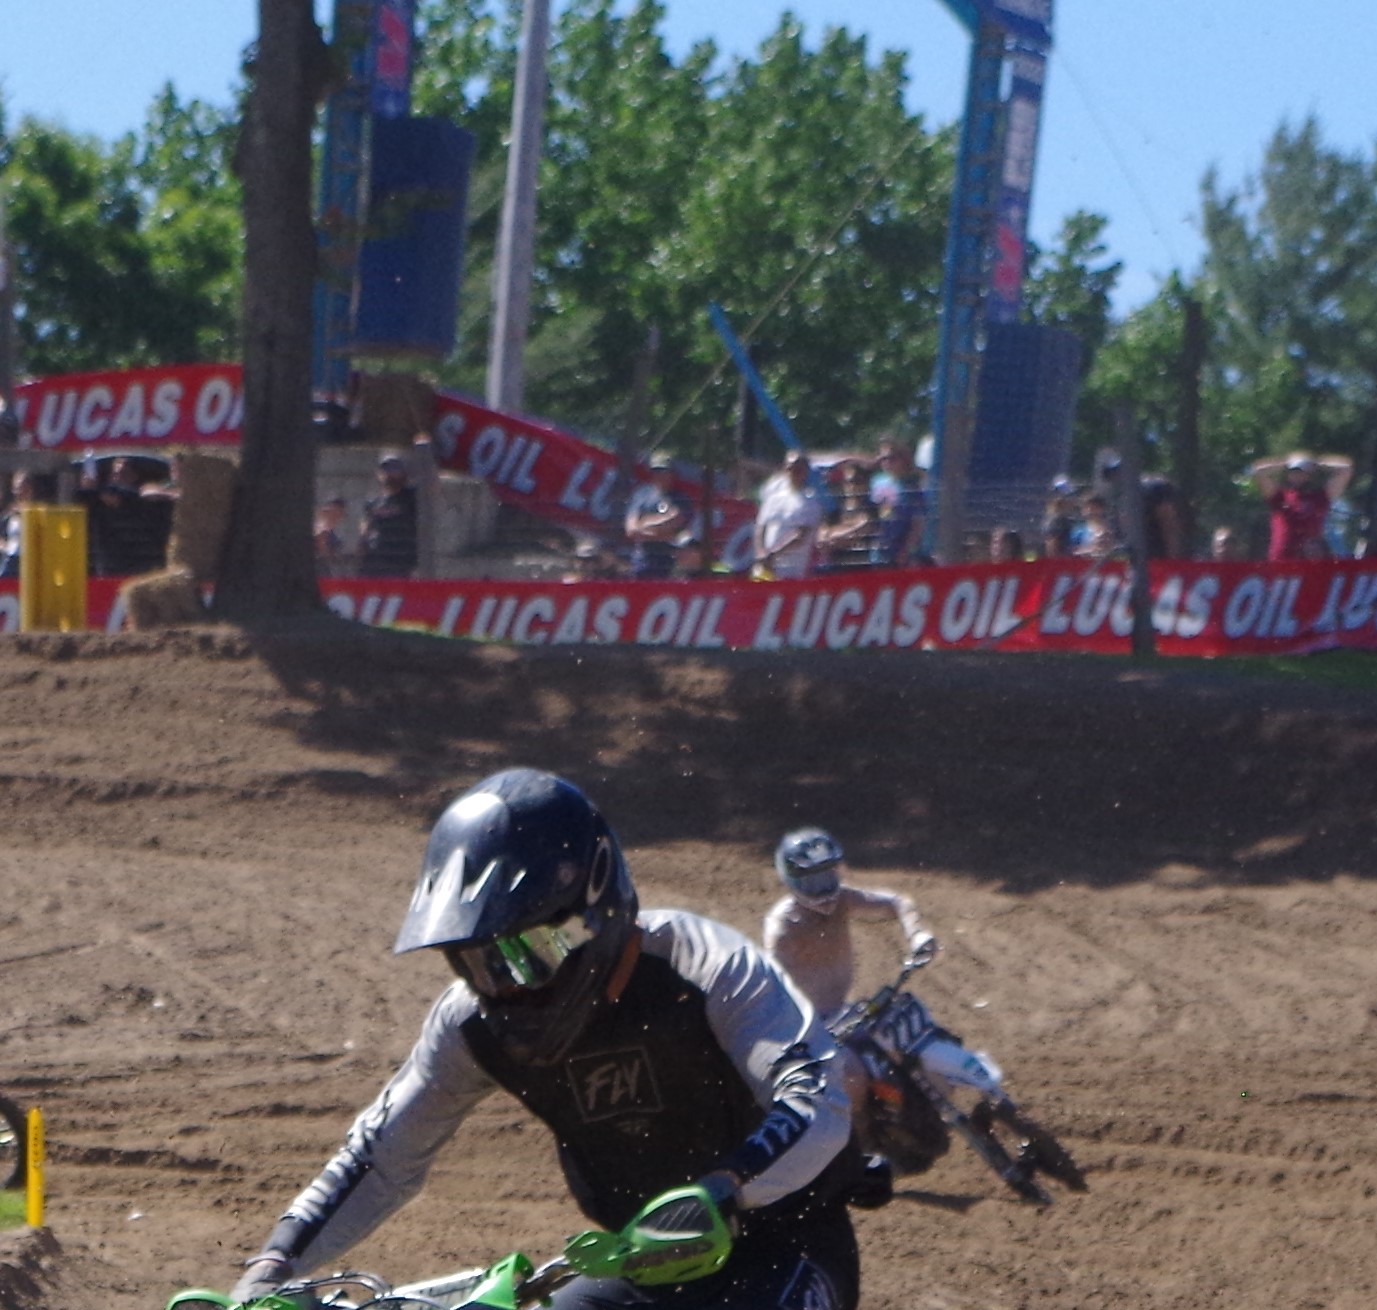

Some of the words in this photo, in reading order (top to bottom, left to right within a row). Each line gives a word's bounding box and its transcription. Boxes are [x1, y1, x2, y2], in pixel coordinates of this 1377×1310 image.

[468, 425, 544, 495] OIL
[437, 594, 629, 646] LUCAS
[636, 596, 725, 648] OIL
[752, 583, 932, 652] LUCAS
[940, 575, 1023, 643] OIL
[1040, 574, 1219, 639] LUCAS
[1225, 574, 1301, 638] OIL
[583, 1058, 641, 1111] FLY
